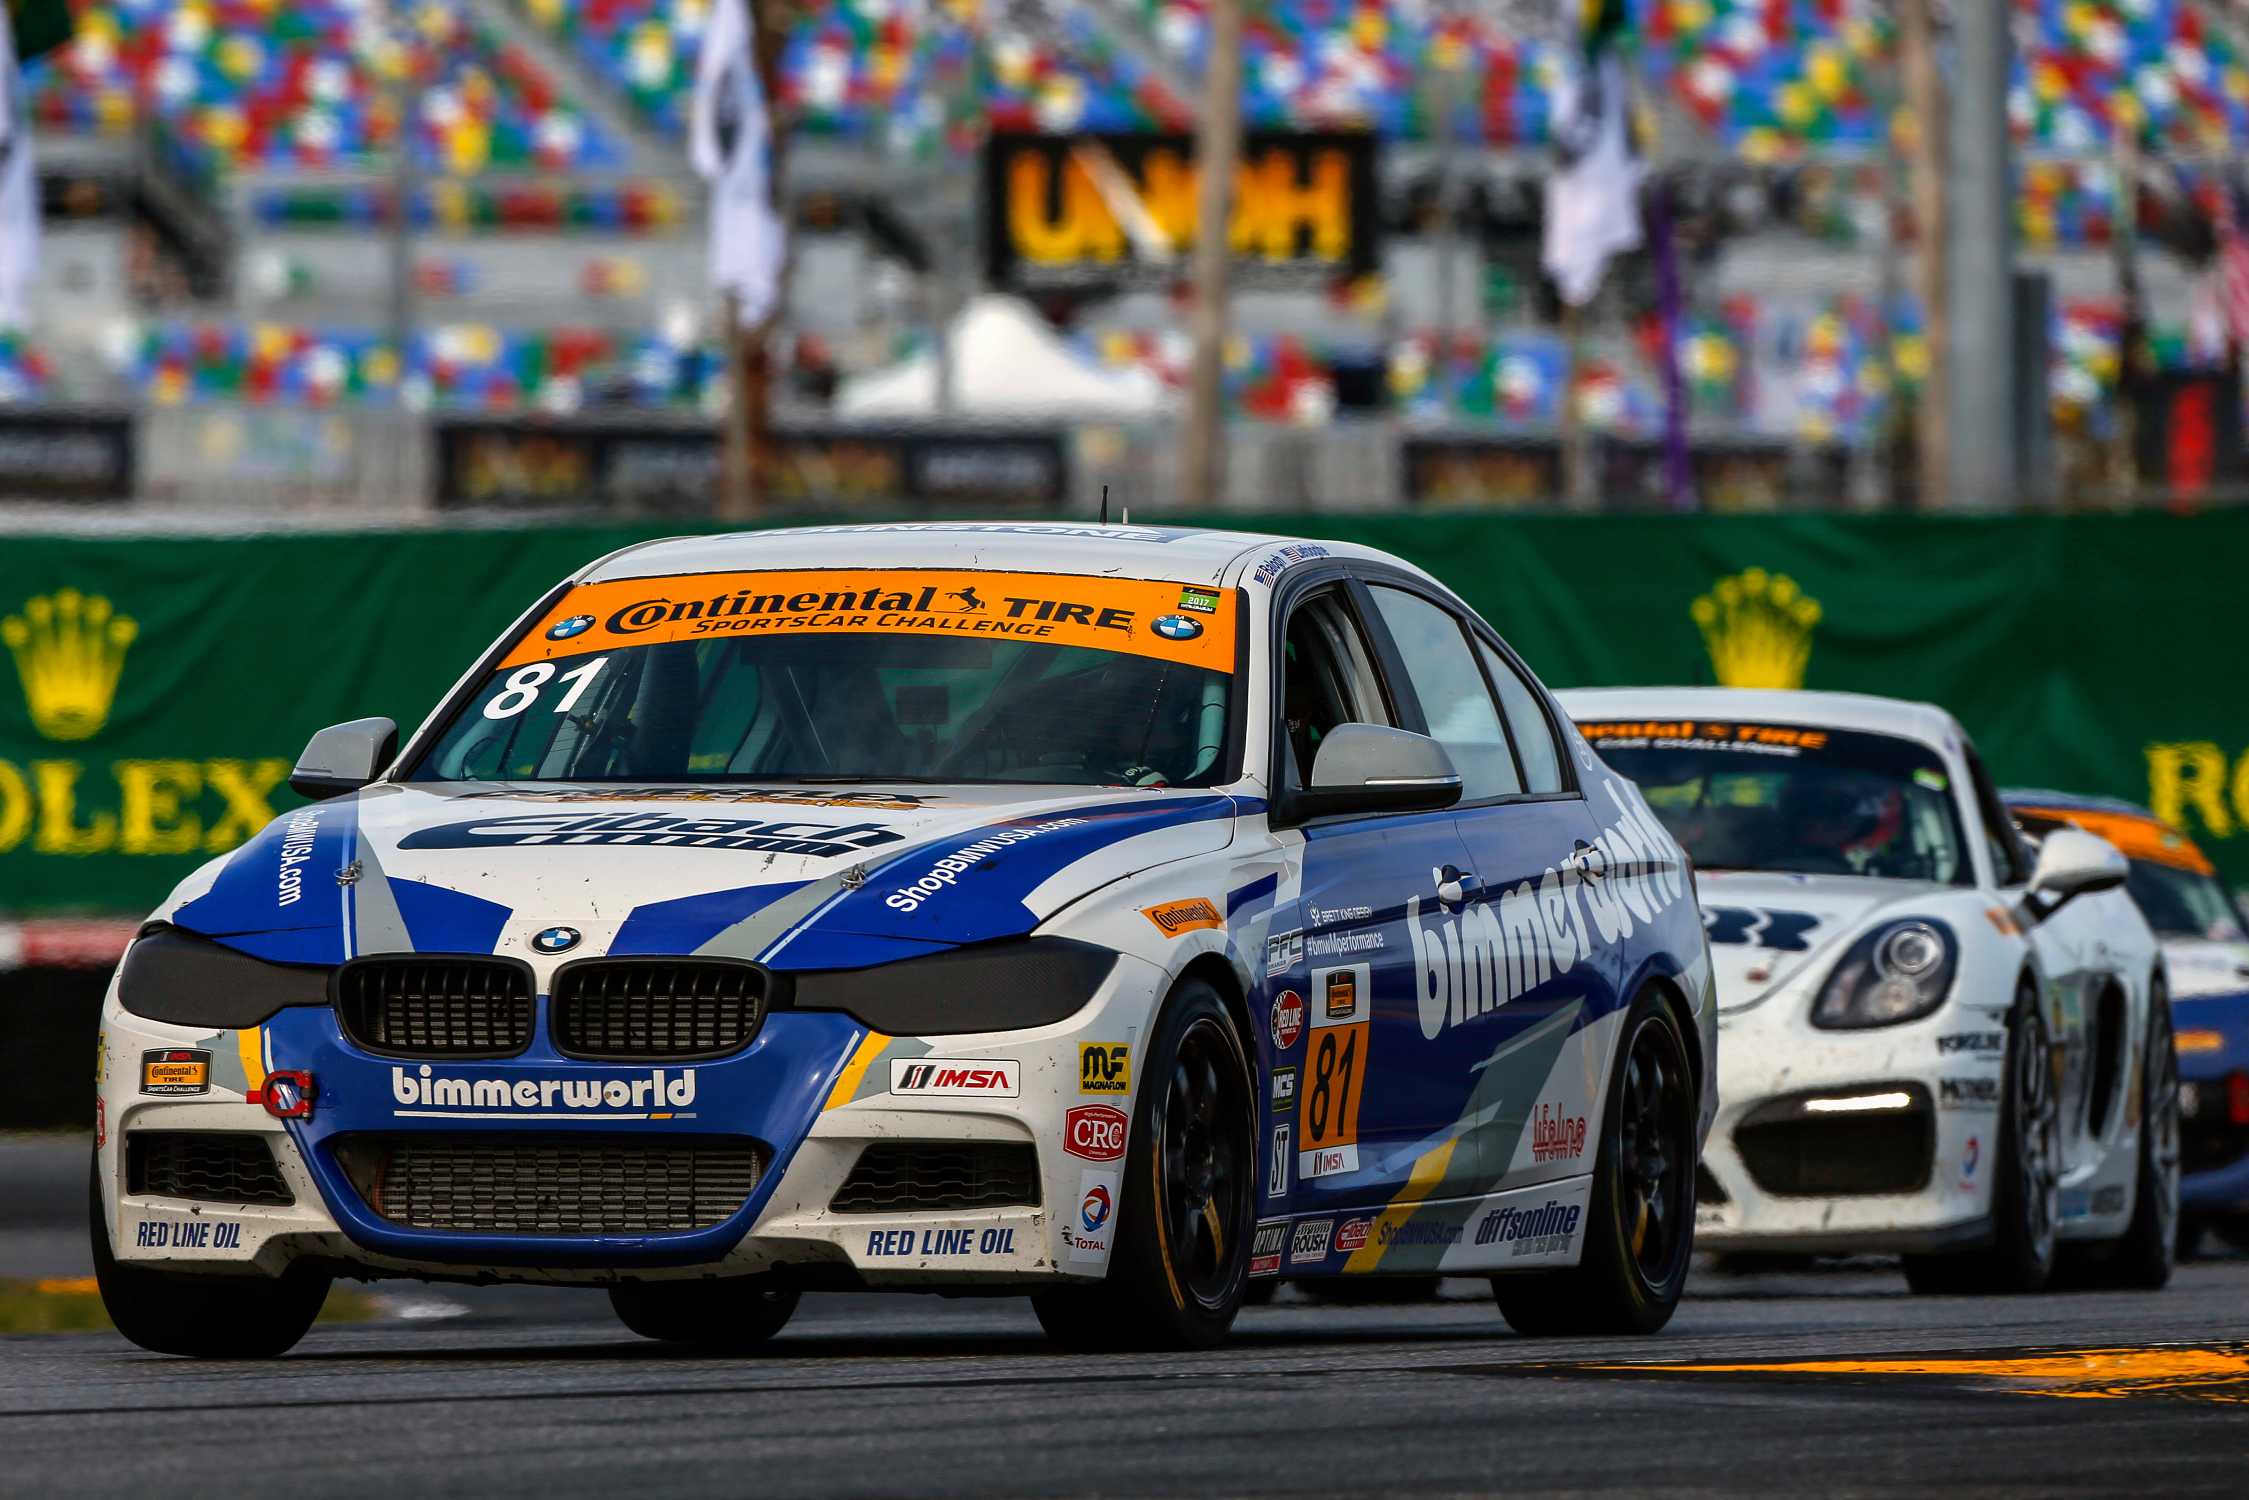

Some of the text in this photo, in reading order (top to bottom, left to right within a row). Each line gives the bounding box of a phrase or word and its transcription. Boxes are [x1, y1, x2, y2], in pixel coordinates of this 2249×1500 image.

[605, 586, 1136, 634] Continental TIRE
[1187, 596, 1210, 607] 2017
[690, 613, 1055, 637] SPORTSCAR CHALLENGE
[483, 657, 609, 720] 81
[397, 812, 906, 857] Eibach
[885, 817, 1088, 912] ShopBMWUSA.com
[1152, 902, 1218, 932] Continental
[1307, 930, 1384, 957] #bmwMperformance
[152, 1065, 191, 1078] Continental
[933, 1069, 1010, 1089] IMSA
[392, 1064, 696, 1108] bimmerworld
[1273, 1073, 1295, 1099] MCS
[1309, 1029, 1357, 1142] 81
[1074, 1118, 1123, 1150] CRC
[1271, 1130, 1288, 1192] ST
[137, 1222, 240, 1248] RED LINE OIL
[1475, 1200, 1581, 1245] diffsonline
[867, 1229, 1015, 1256] RED LINE OIL
[1075, 1237, 1105, 1251] TOTAL
[1252, 1227, 1286, 1254] OPTIMA
[1292, 1233, 1328, 1254] ROUSH
